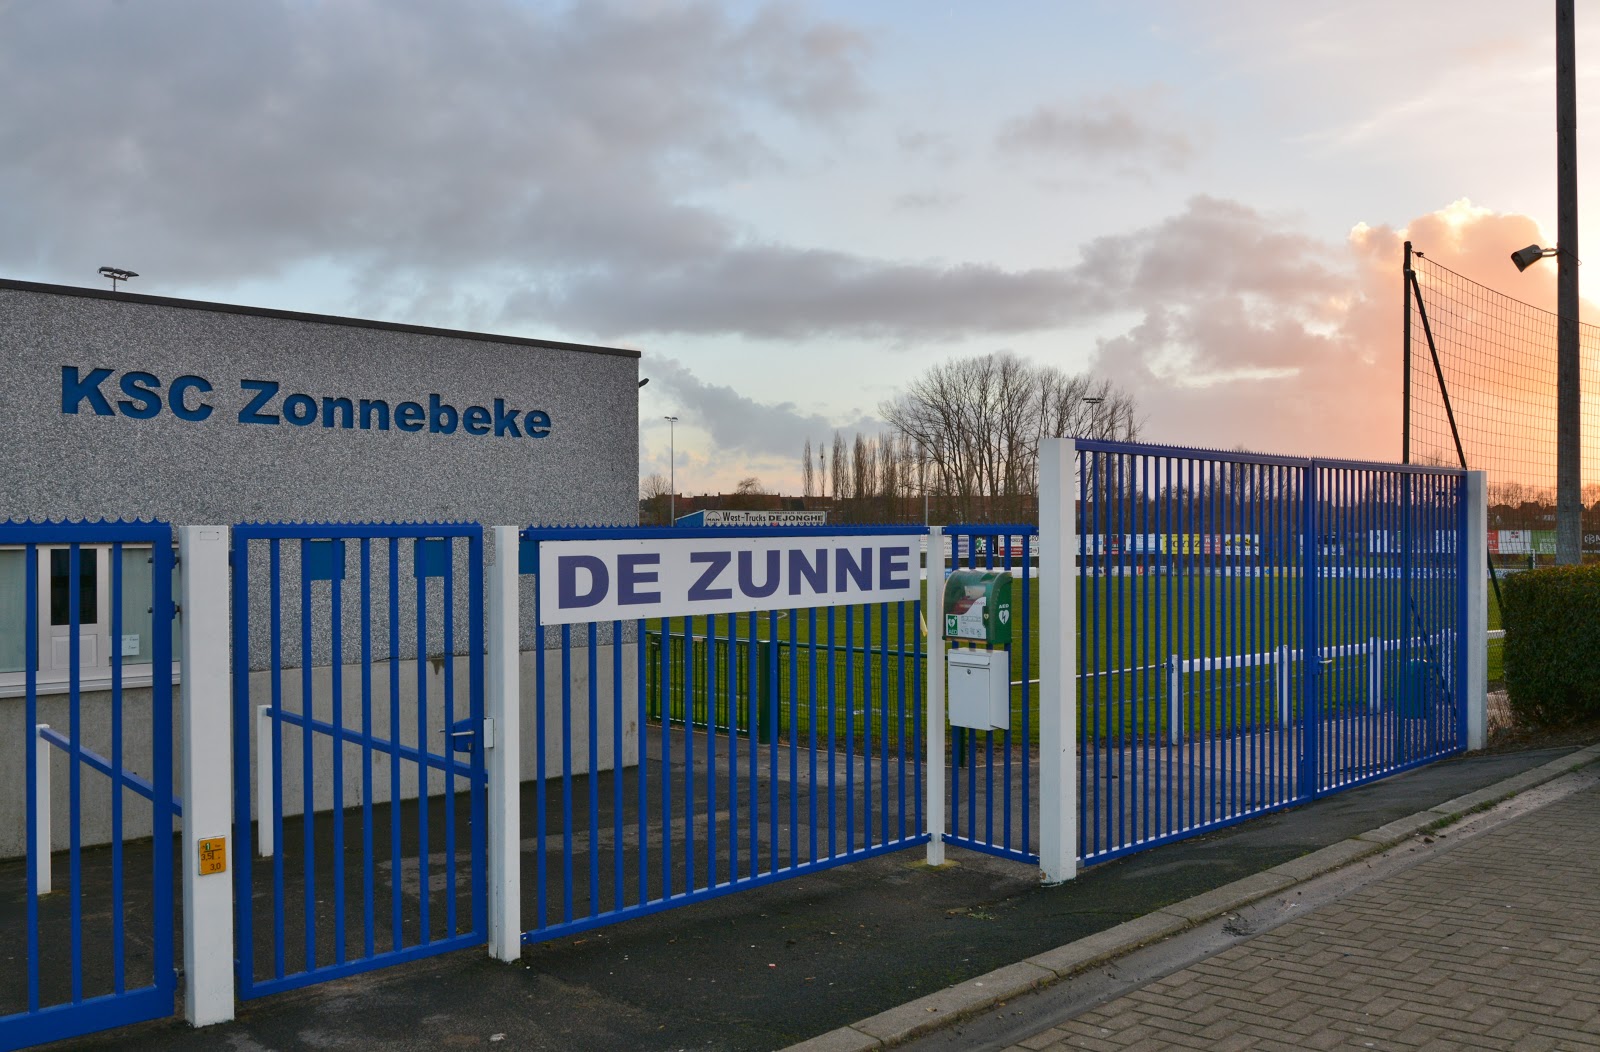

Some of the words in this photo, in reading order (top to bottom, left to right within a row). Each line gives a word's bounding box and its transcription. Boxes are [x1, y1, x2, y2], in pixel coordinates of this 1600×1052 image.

[61, 365, 214, 421] KSC
[237, 379, 552, 438] Zonnebeke
[722, 511, 766, 522] West-Trucks
[558, 553, 661, 610] DE
[687, 546, 910, 601] ZUNNE
